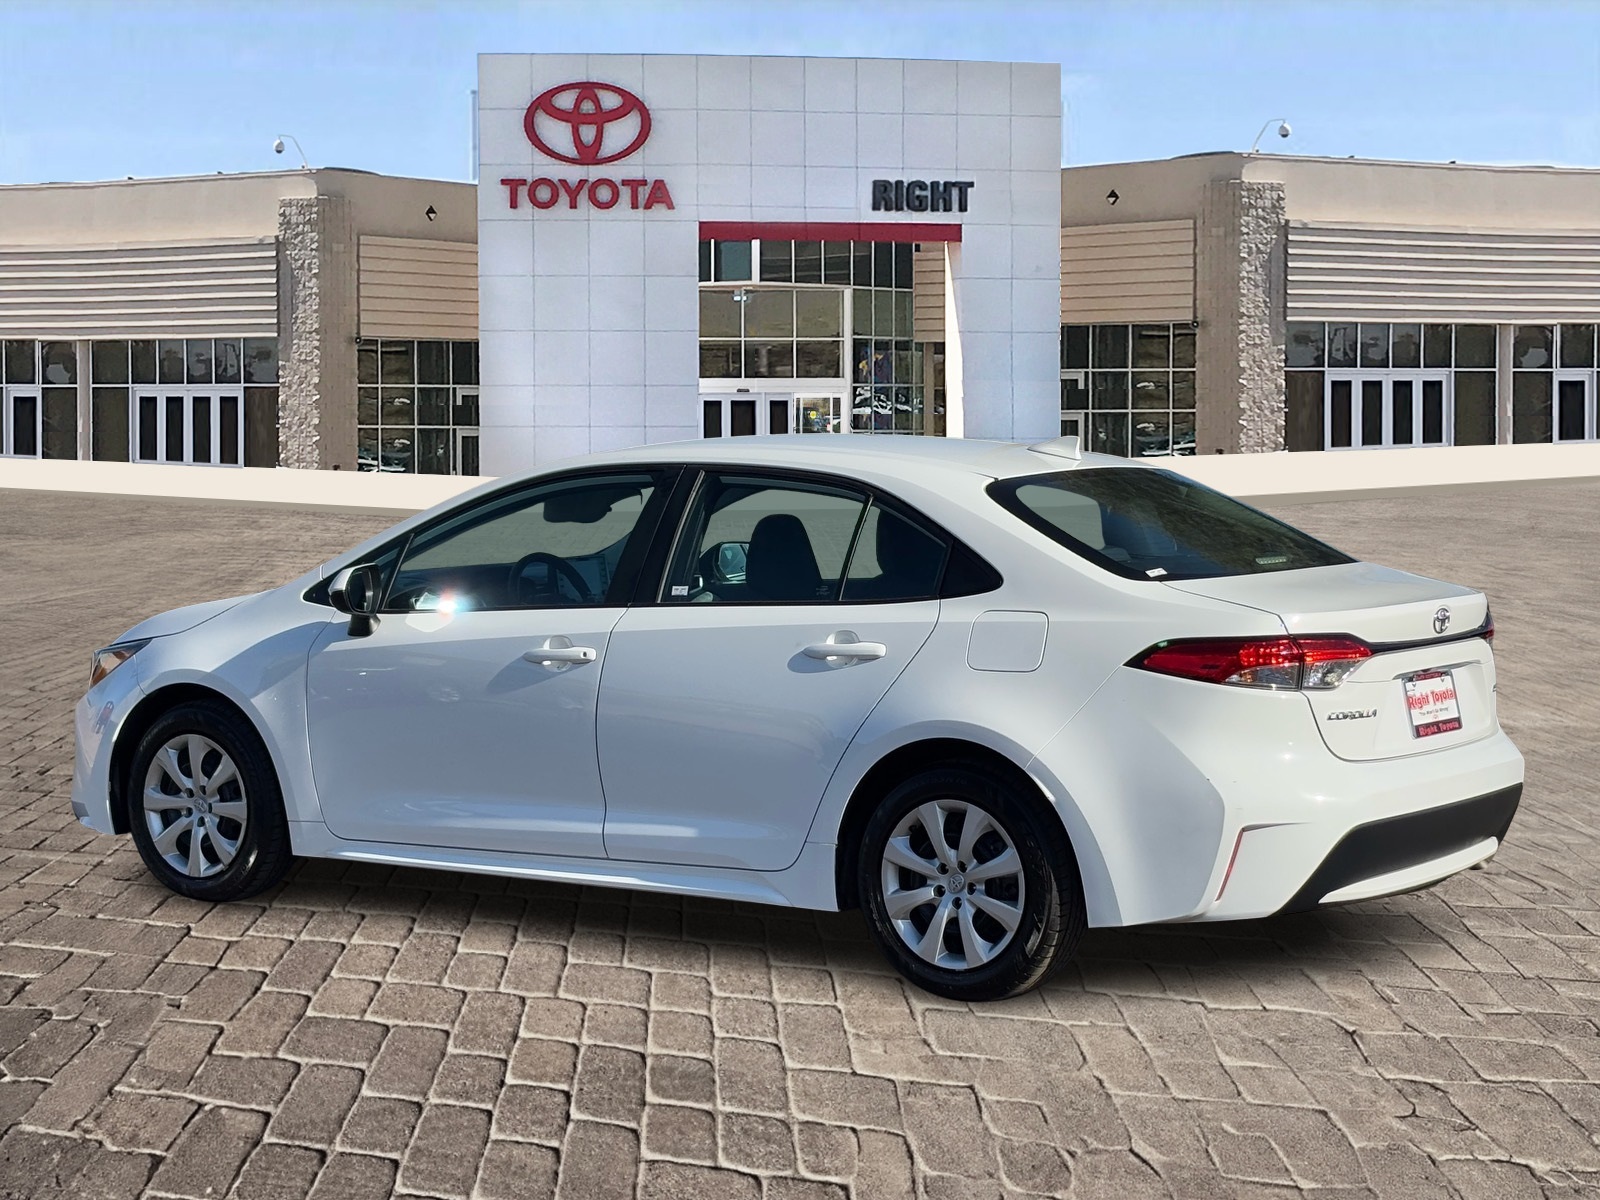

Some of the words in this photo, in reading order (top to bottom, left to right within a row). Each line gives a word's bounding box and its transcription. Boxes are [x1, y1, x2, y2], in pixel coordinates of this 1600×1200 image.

[500, 178, 675, 210] TOYOTA
[871, 180, 975, 212] RIGHT
[1408, 694, 1430, 710] Right
[1430, 688, 1454, 705] Toyota
[1326, 709, 1378, 721] COROLLA
[1418, 724, 1438, 737] Right
[1438, 720, 1459, 732] Toyota
